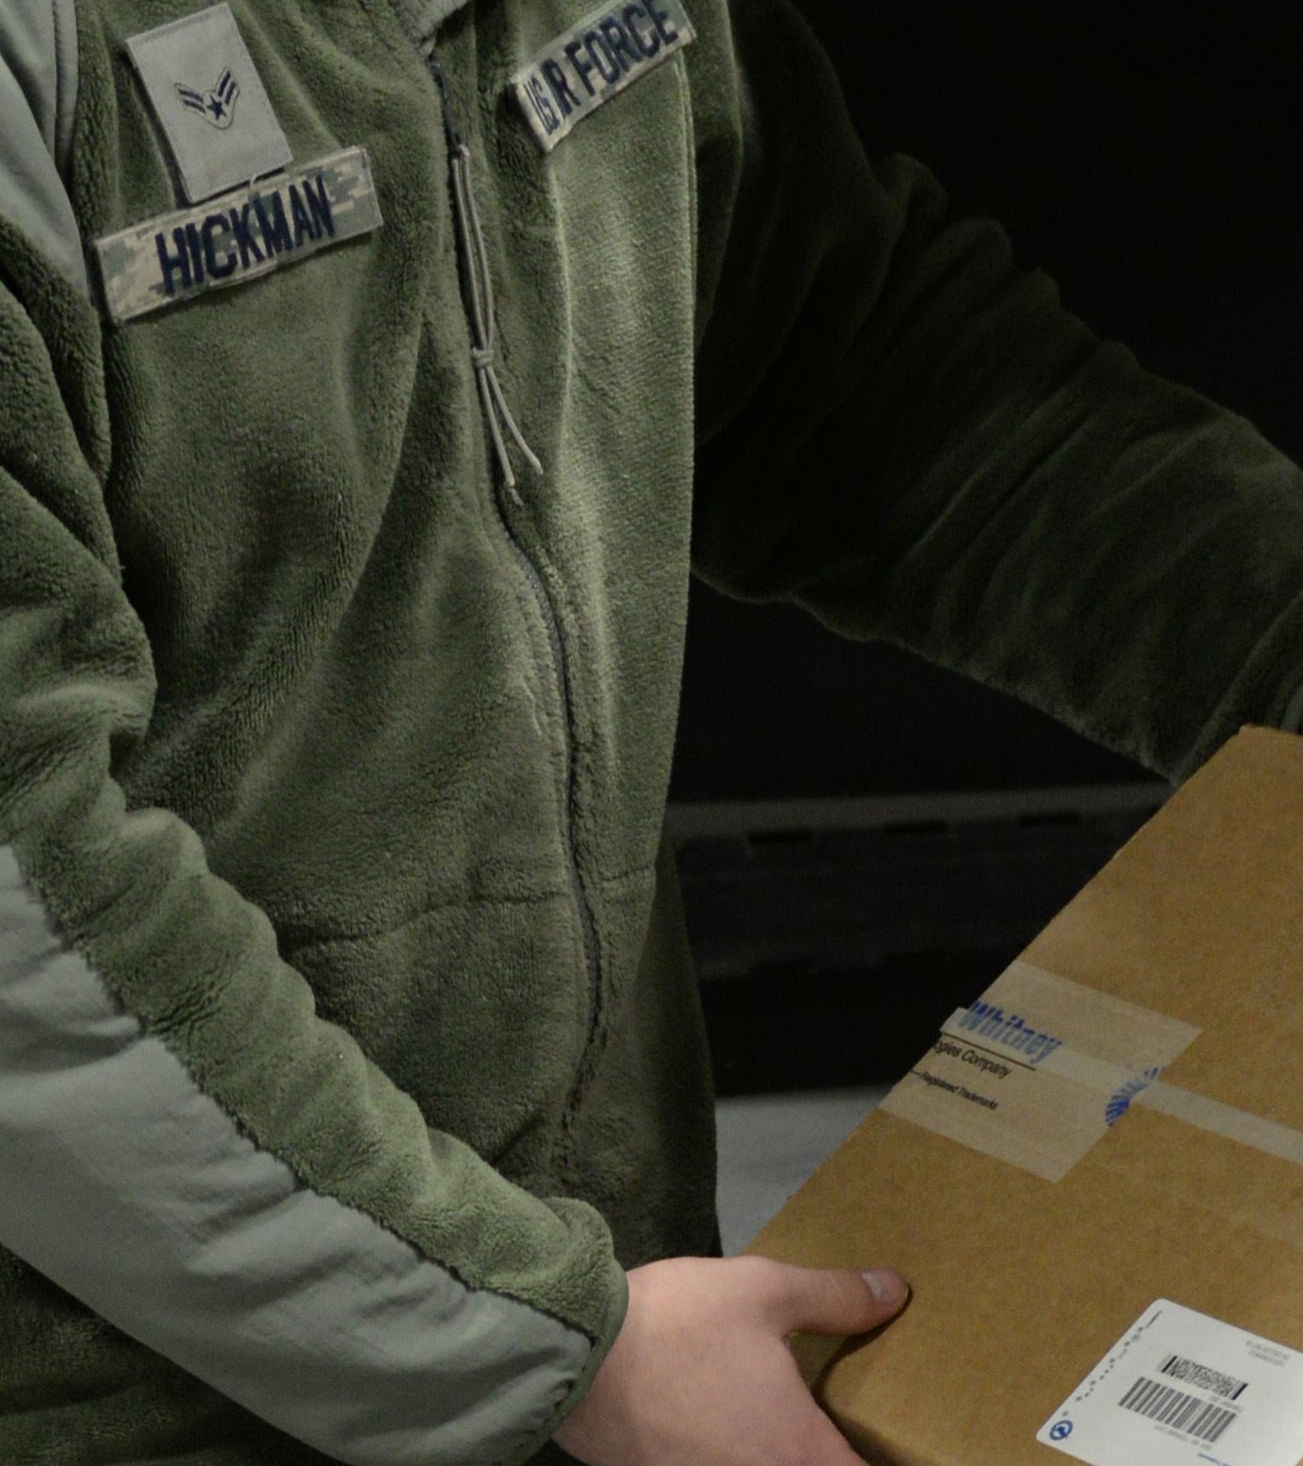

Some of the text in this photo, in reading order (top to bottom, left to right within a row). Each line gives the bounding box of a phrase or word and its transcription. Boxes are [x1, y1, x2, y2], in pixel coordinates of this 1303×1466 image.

[155, 173, 335, 295] HICKMAN
[956, 999, 1063, 1065] Whitney
[960, 1049, 1013, 1080] Company
